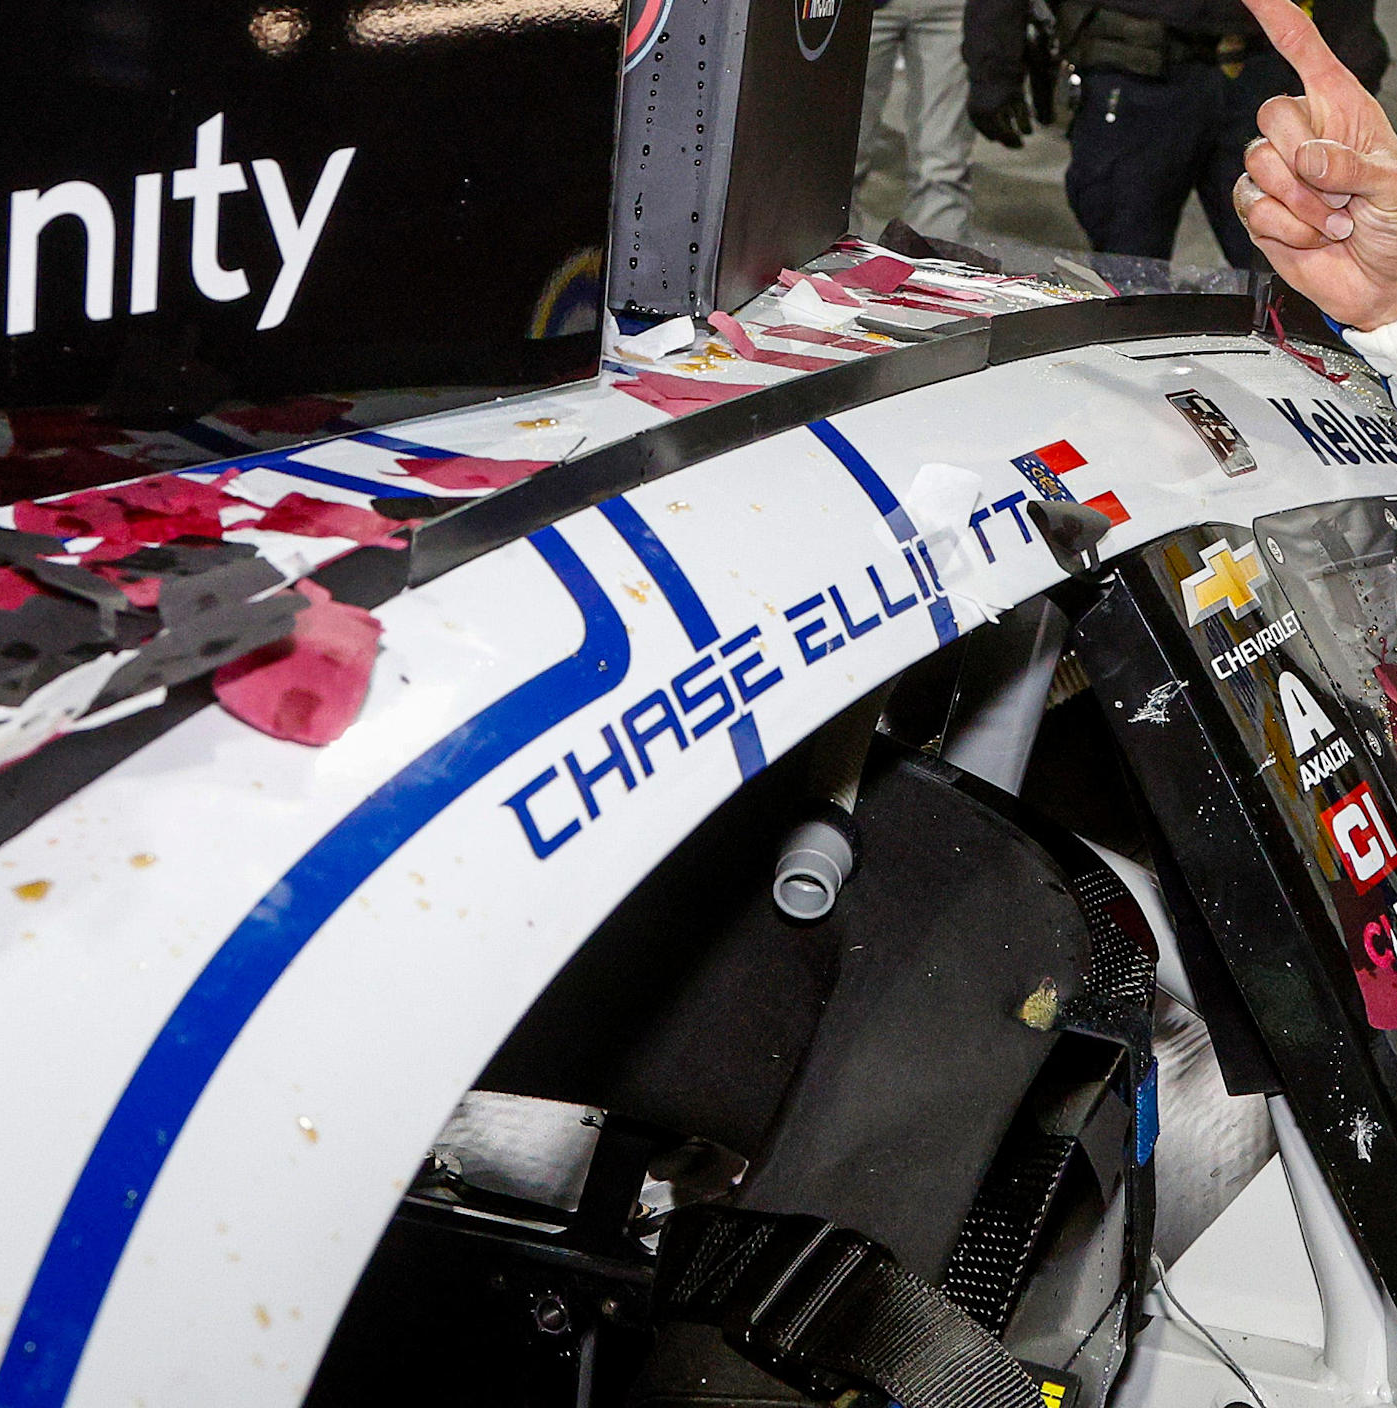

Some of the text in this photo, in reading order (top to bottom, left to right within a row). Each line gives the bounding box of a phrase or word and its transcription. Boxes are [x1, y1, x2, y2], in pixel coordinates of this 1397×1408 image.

[1210, 610, 1301, 681] CHEVROLET
[500, 624, 785, 860] CHASE
[1299, 737, 1355, 792] AXALTA
